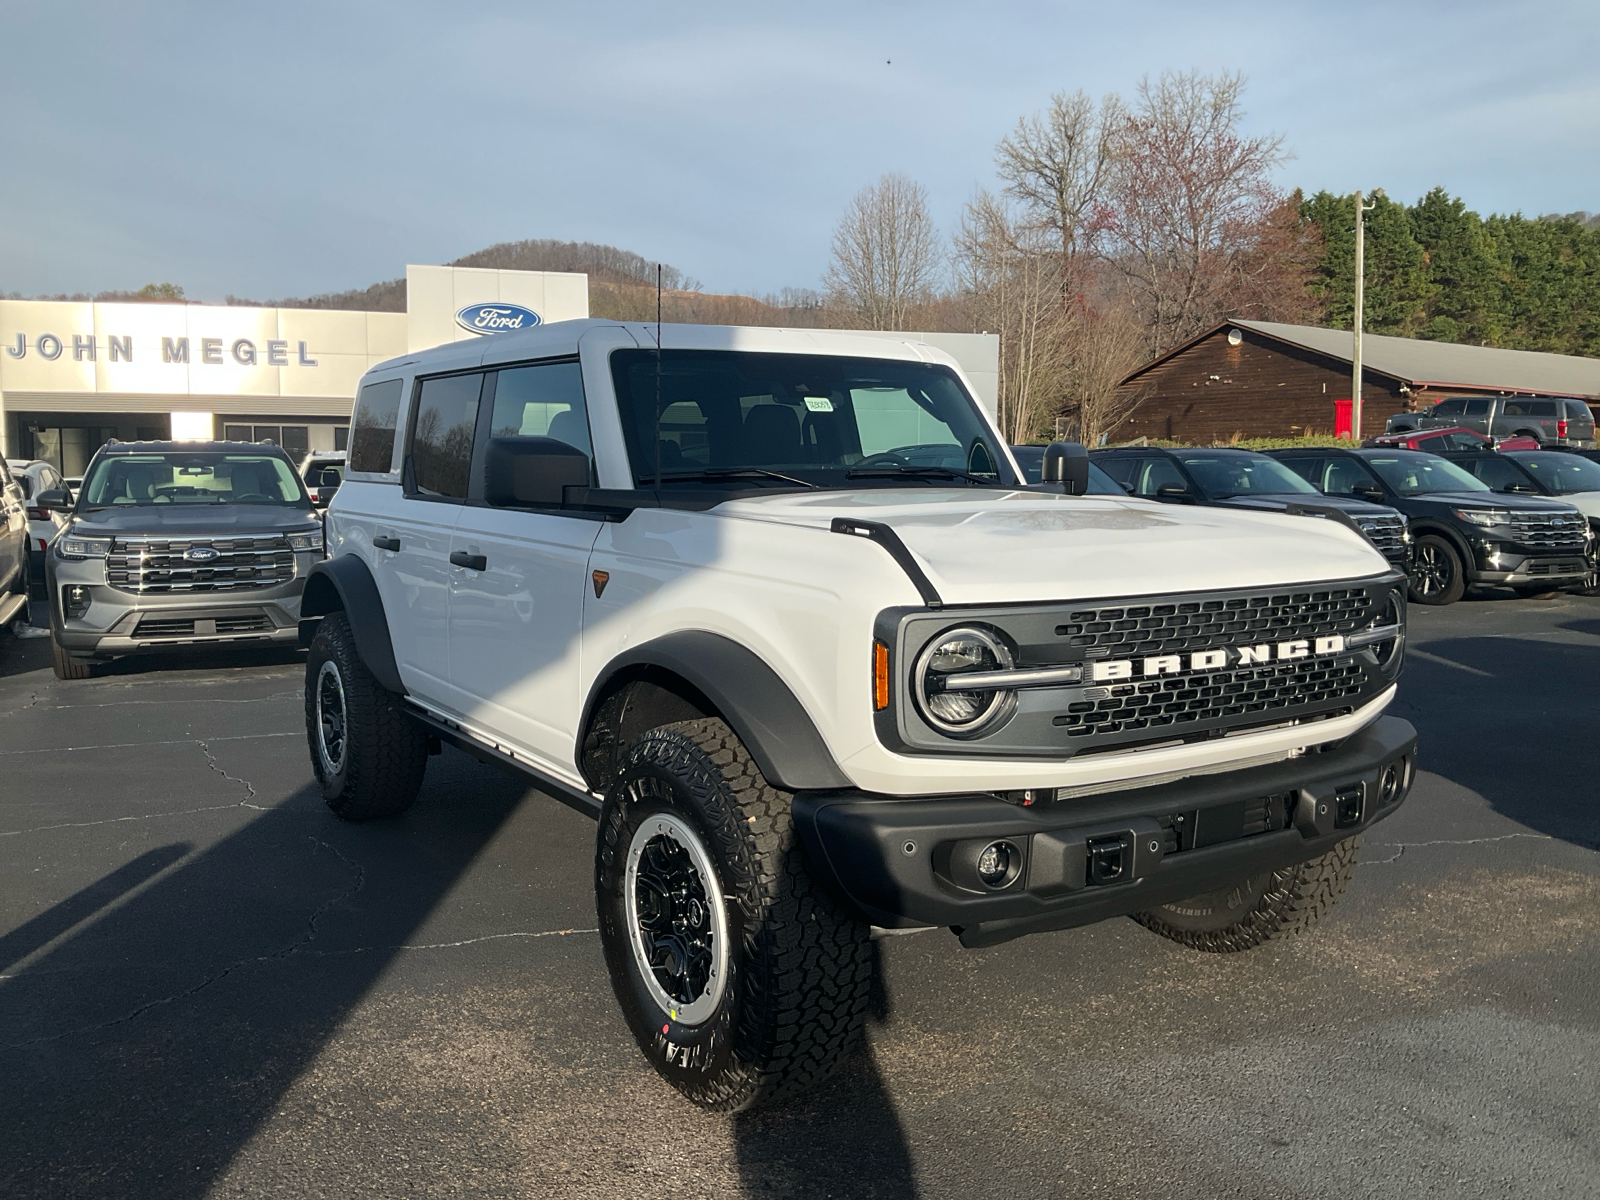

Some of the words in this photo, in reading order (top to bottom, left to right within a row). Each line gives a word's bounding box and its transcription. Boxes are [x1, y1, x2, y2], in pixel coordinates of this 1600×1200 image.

[475, 308, 523, 328] Ford
[7, 333, 132, 362] JOHN
[162, 337, 318, 366] MEGEL
[1093, 636, 1343, 681] BRONCO
[1162, 902, 1213, 917] TERRITOR
